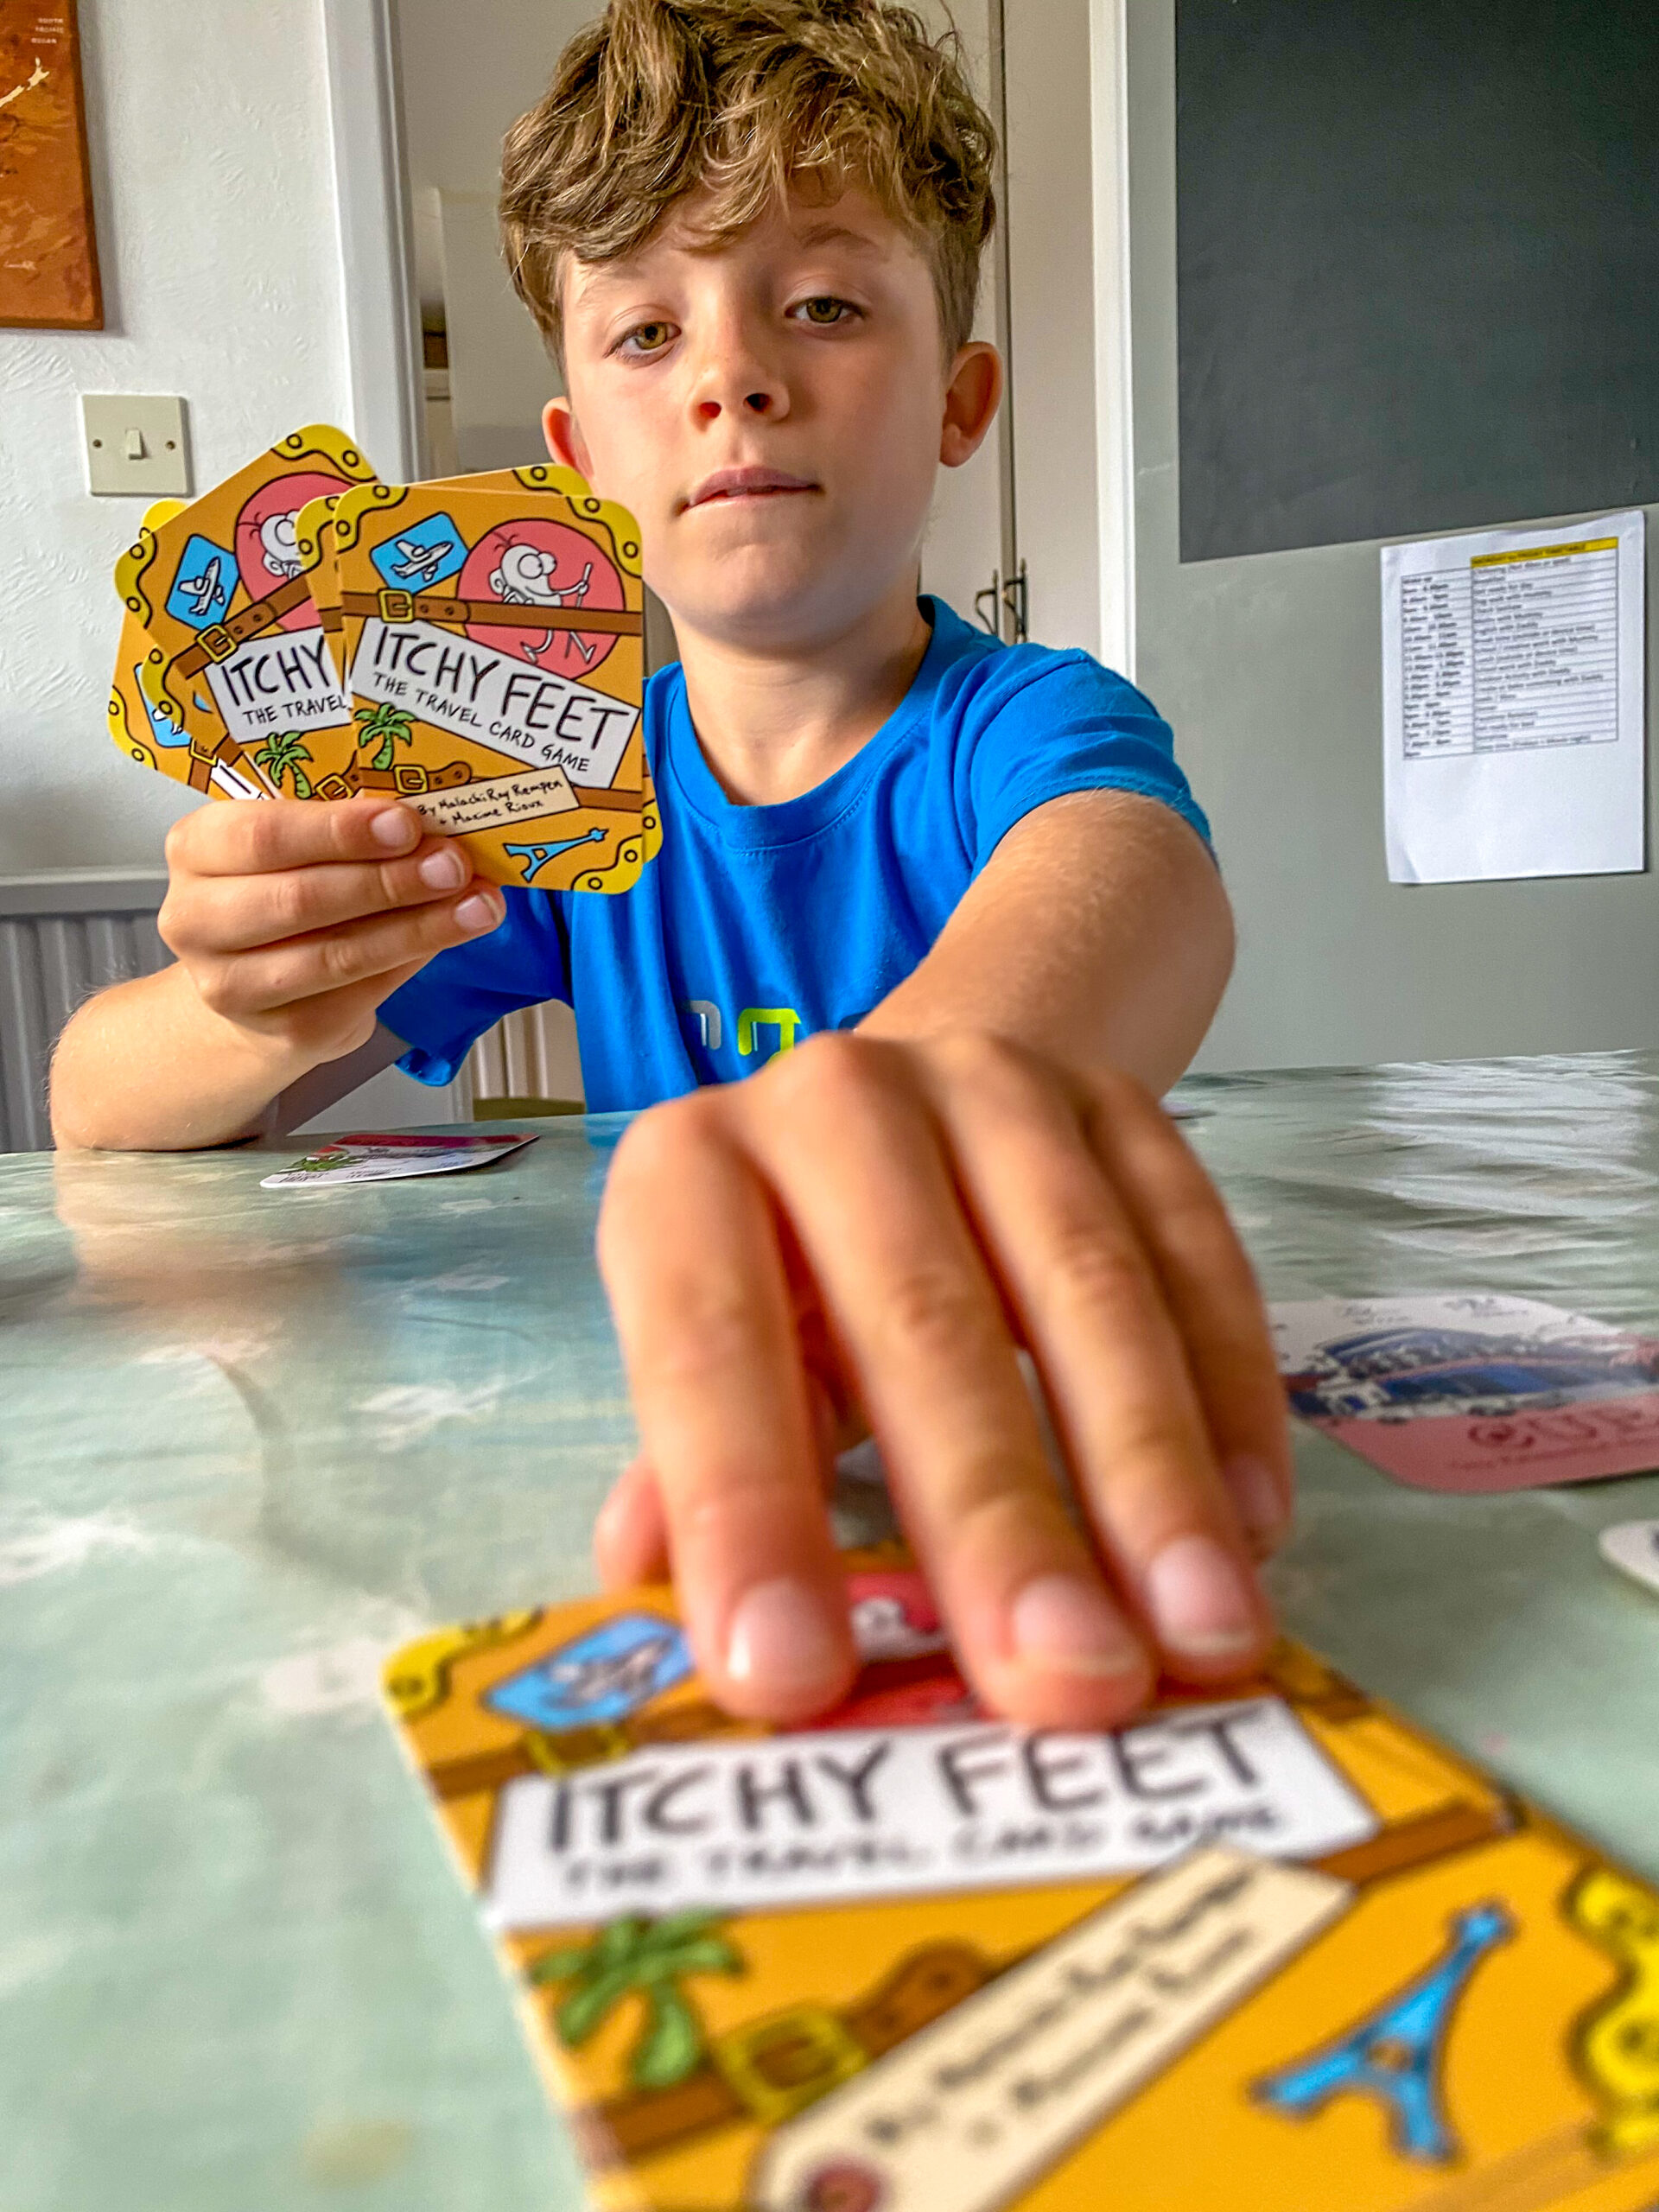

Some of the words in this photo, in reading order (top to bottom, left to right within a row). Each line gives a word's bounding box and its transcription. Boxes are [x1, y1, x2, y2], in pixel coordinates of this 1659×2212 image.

[220, 634, 331, 707] ITCHY
[242, 705, 279, 726] THE
[281, 694, 347, 719] TRAVEL
[373, 626, 500, 702] ITCHY
[500, 672, 630, 750] FEET
[372, 672, 409, 696] THE
[416, 688, 483, 728] TRAVEL
[489, 720, 535, 749] CARD
[541, 743, 591, 773] GAME
[417, 804, 436, 817] By
[548, 1737, 895, 1854] ITCHY
[933, 1702, 1268, 1818] FEET
